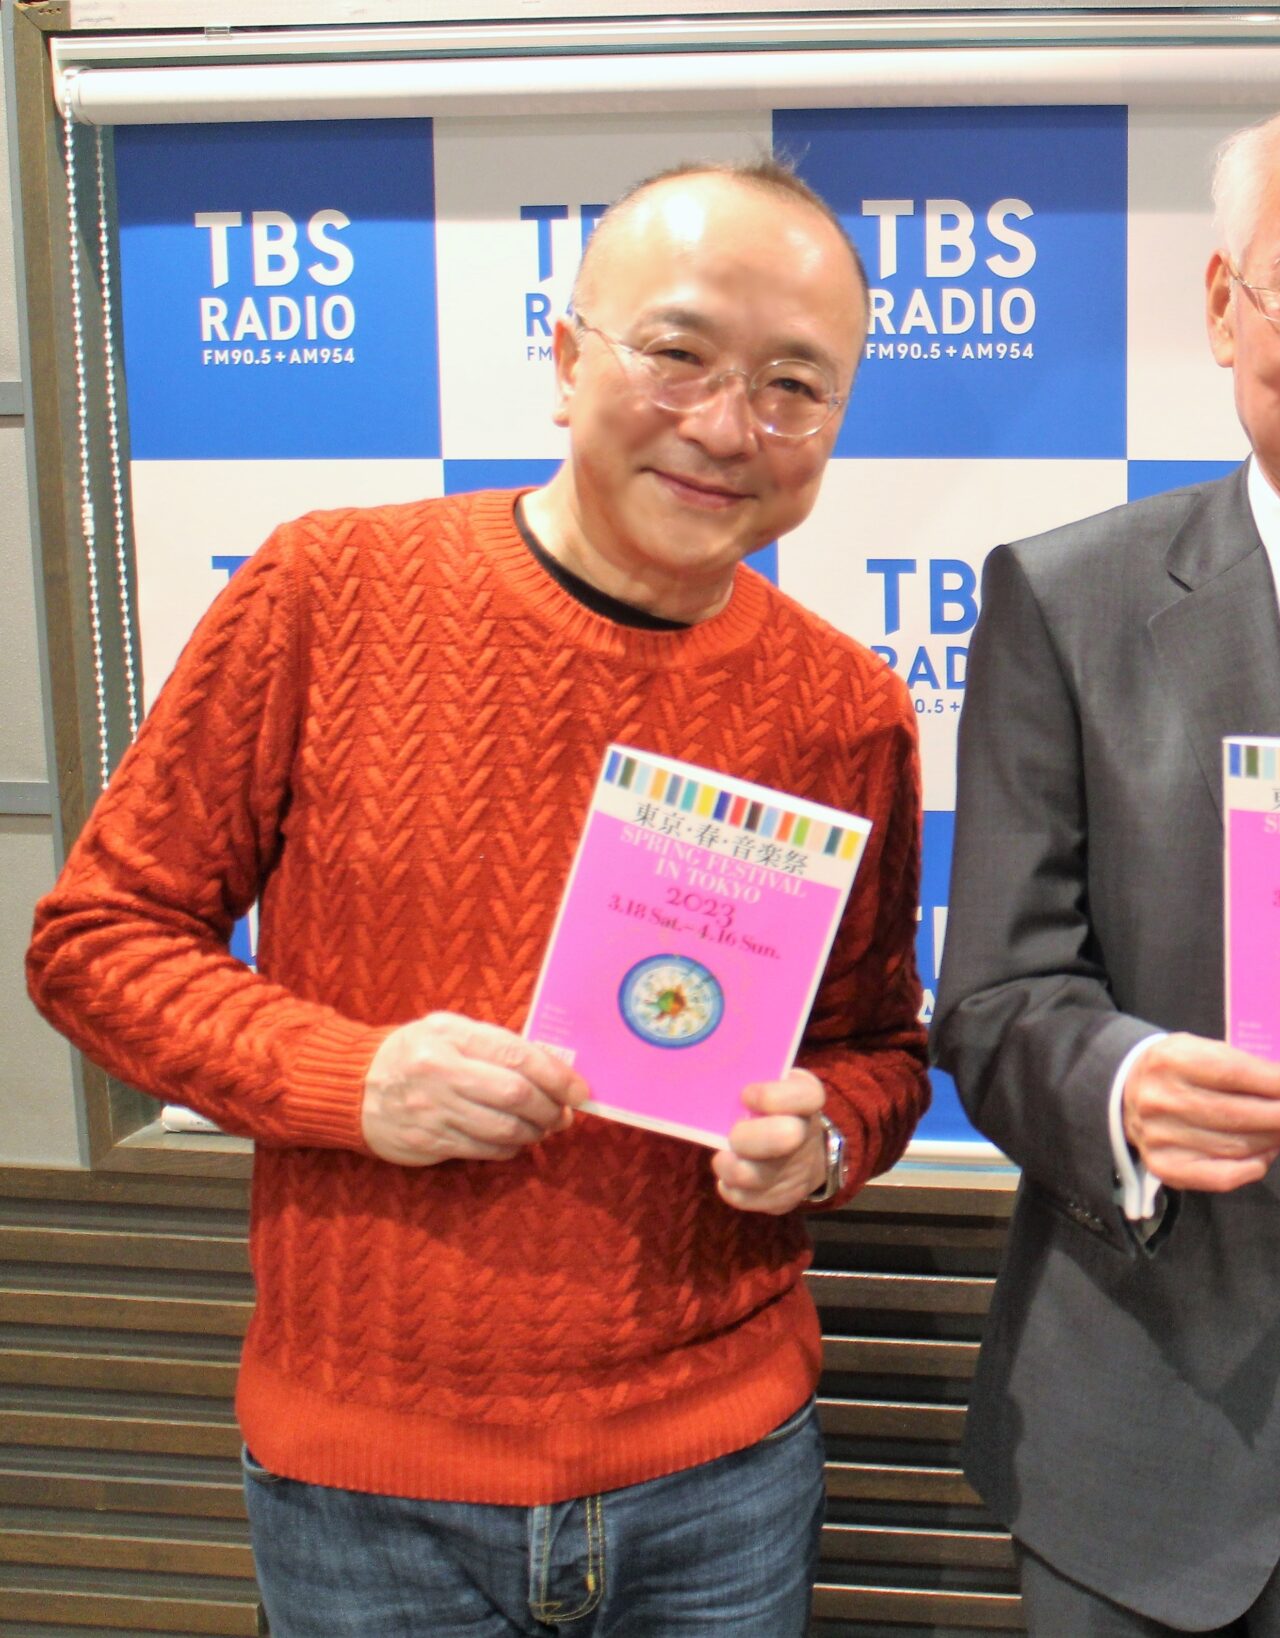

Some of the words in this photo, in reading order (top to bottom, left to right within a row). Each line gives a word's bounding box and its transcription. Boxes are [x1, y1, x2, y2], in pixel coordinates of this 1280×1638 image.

[195, 209, 354, 289] TBS
[862, 198, 1037, 280] TBS
[200, 294, 355, 341] RADIO
[867, 287, 1036, 335] RADIO
[866, 559, 978, 635] TB
[620, 825, 699, 867] SPRING
[705, 852, 807, 899] FESTIVAL
[655, 857, 682, 881] IN
[687, 866, 762, 905] TOKYO
[667, 887, 736, 929] 2023
